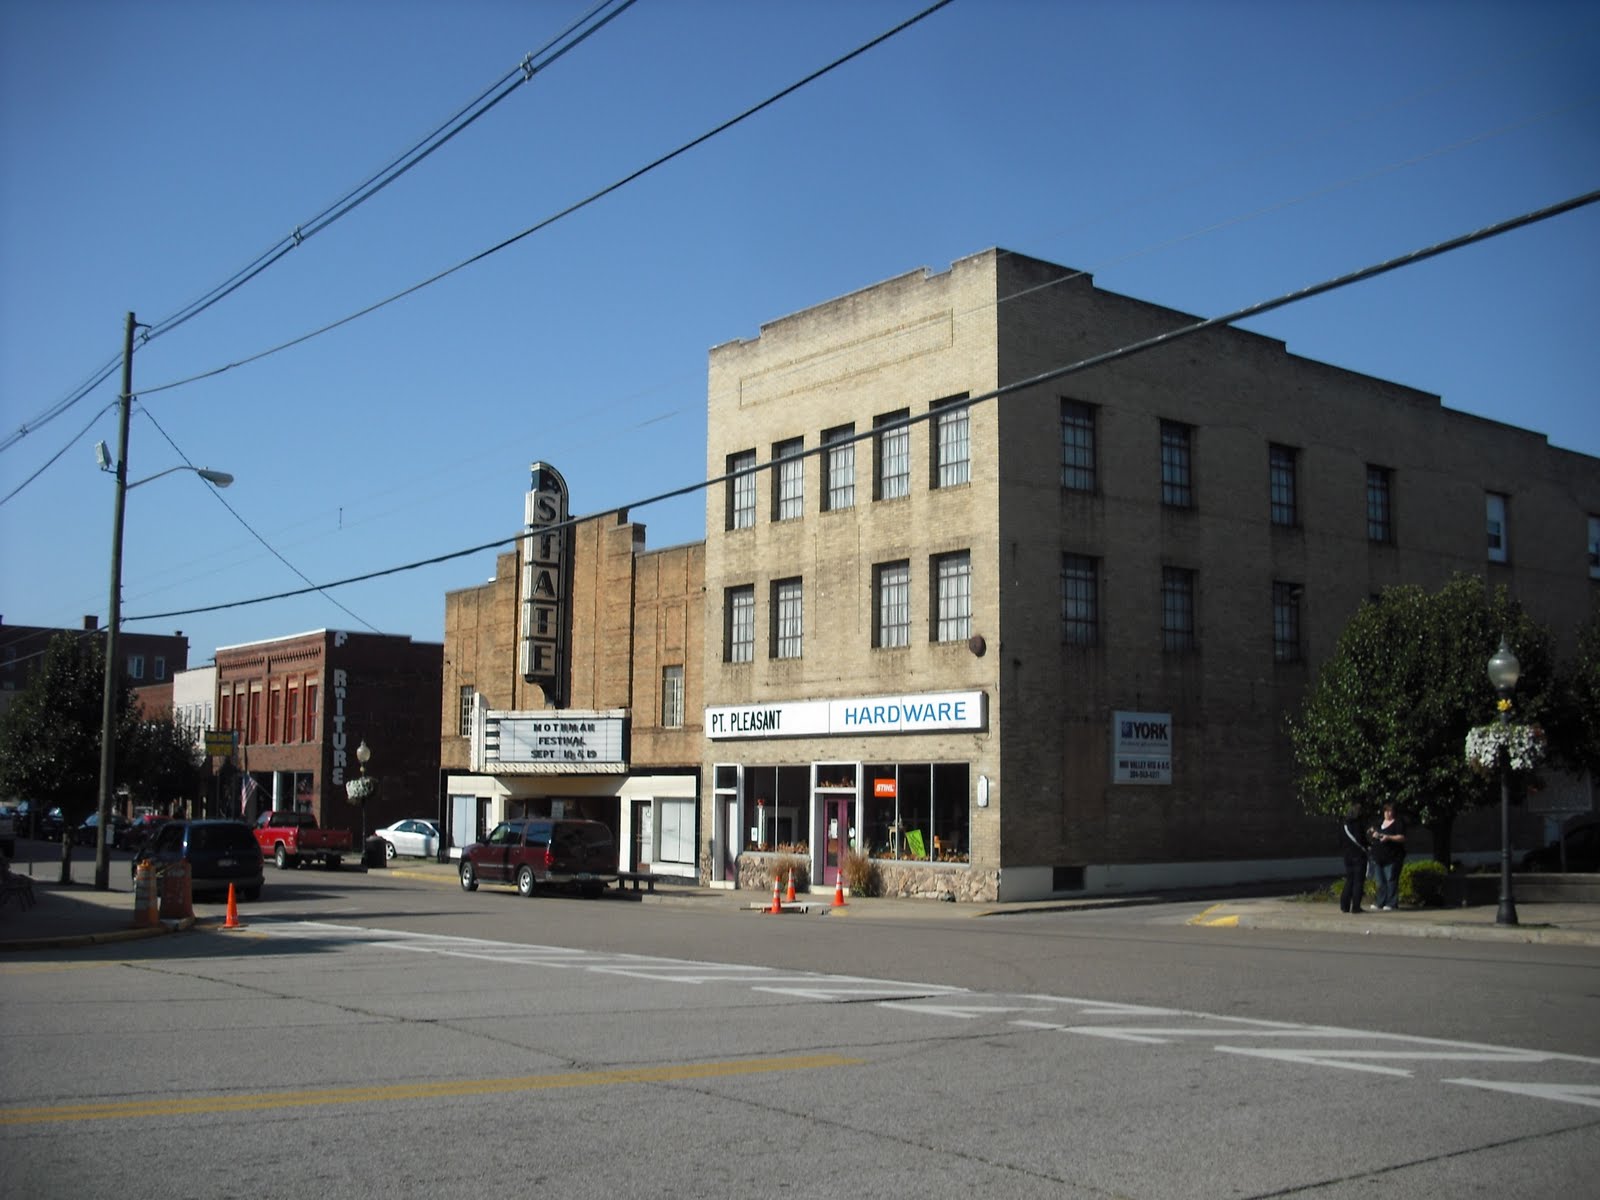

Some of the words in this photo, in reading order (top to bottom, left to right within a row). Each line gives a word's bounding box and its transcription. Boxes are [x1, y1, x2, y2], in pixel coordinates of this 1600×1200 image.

[533, 495, 557, 672] STATE
[845, 701, 966, 725] HARDWARE
[533, 723, 596, 733] MOTHMAN
[712, 713, 727, 733] PT.
[730, 709, 782, 732] PLEASANT
[1133, 721, 1168, 740] YORK
[538, 736, 587, 747] FESTIVAL
[530, 749, 556, 759] SEPT
[587, 749, 598, 759] 19
[876, 783, 894, 792] STIHL
